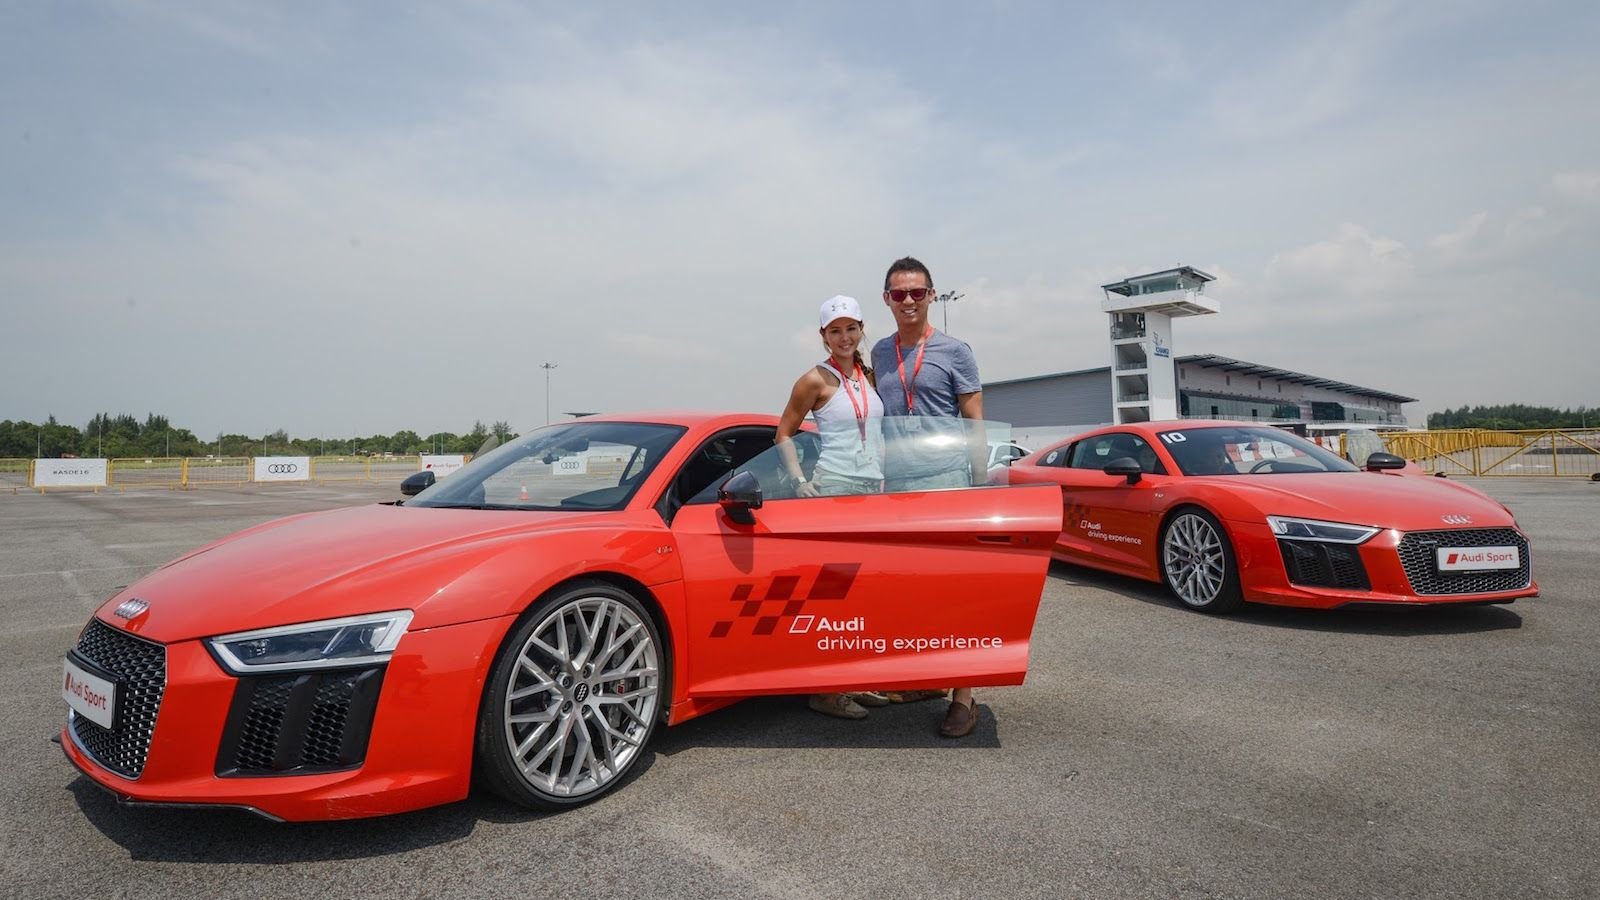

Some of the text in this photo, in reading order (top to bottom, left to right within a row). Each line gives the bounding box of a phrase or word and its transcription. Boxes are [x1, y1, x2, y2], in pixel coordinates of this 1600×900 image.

[1161, 432, 1187, 444] 10
[1087, 522, 1101, 530] Audi
[1087, 530, 1142, 545] driving experience
[1460, 552, 1513, 564] Audi Sport
[816, 617, 865, 632] Audi
[817, 634, 1003, 653] driving experience
[70, 675, 106, 710] Audi Sport
